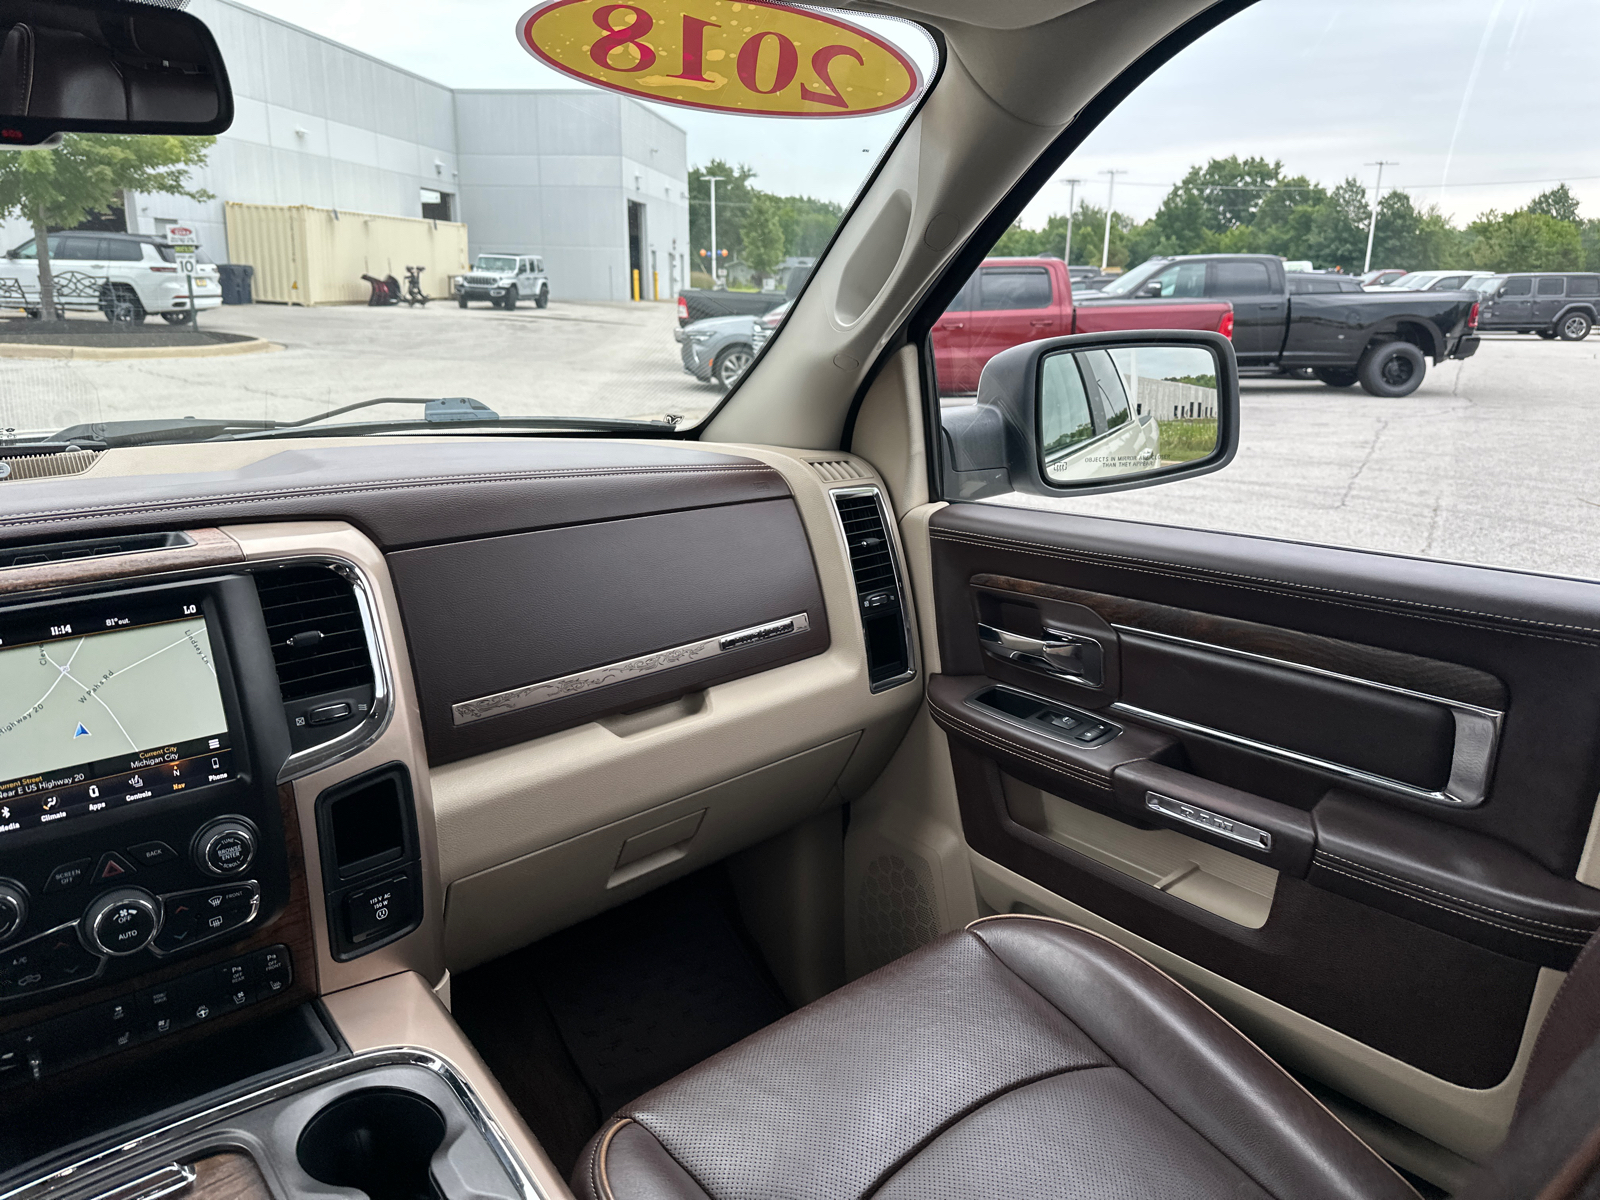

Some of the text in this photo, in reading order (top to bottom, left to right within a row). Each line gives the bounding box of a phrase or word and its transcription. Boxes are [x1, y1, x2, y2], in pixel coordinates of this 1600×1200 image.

[180, 260, 194, 272] 10
[50, 624, 72, 636] 11:14
[184, 629, 209, 664] Lindsey Ln
[78, 670, 114, 704] W Pahs Rd
[33, 704, 44, 713] 20
[139, 749, 163, 759] Current
[130, 757, 163, 769] Michigan
[0, 776, 43, 790] urrent Street
[208, 773, 228, 782] Phone
[18, 786, 24, 795] E
[25, 783, 37, 792] US
[39, 776, 73, 790] Highway
[126, 791, 152, 802] Controls
[89, 802, 106, 811] Apps
[41, 811, 67, 822] Climate
[146, 849, 162, 858] BACK
[218, 845, 242, 857] BROWSE
[222, 851, 240, 860] ENTER
[56, 869, 81, 880] SCREEN
[226, 891, 243, 899] FRONT
[118, 915, 132, 924] OFF
[118, 930, 138, 940] AUTO
